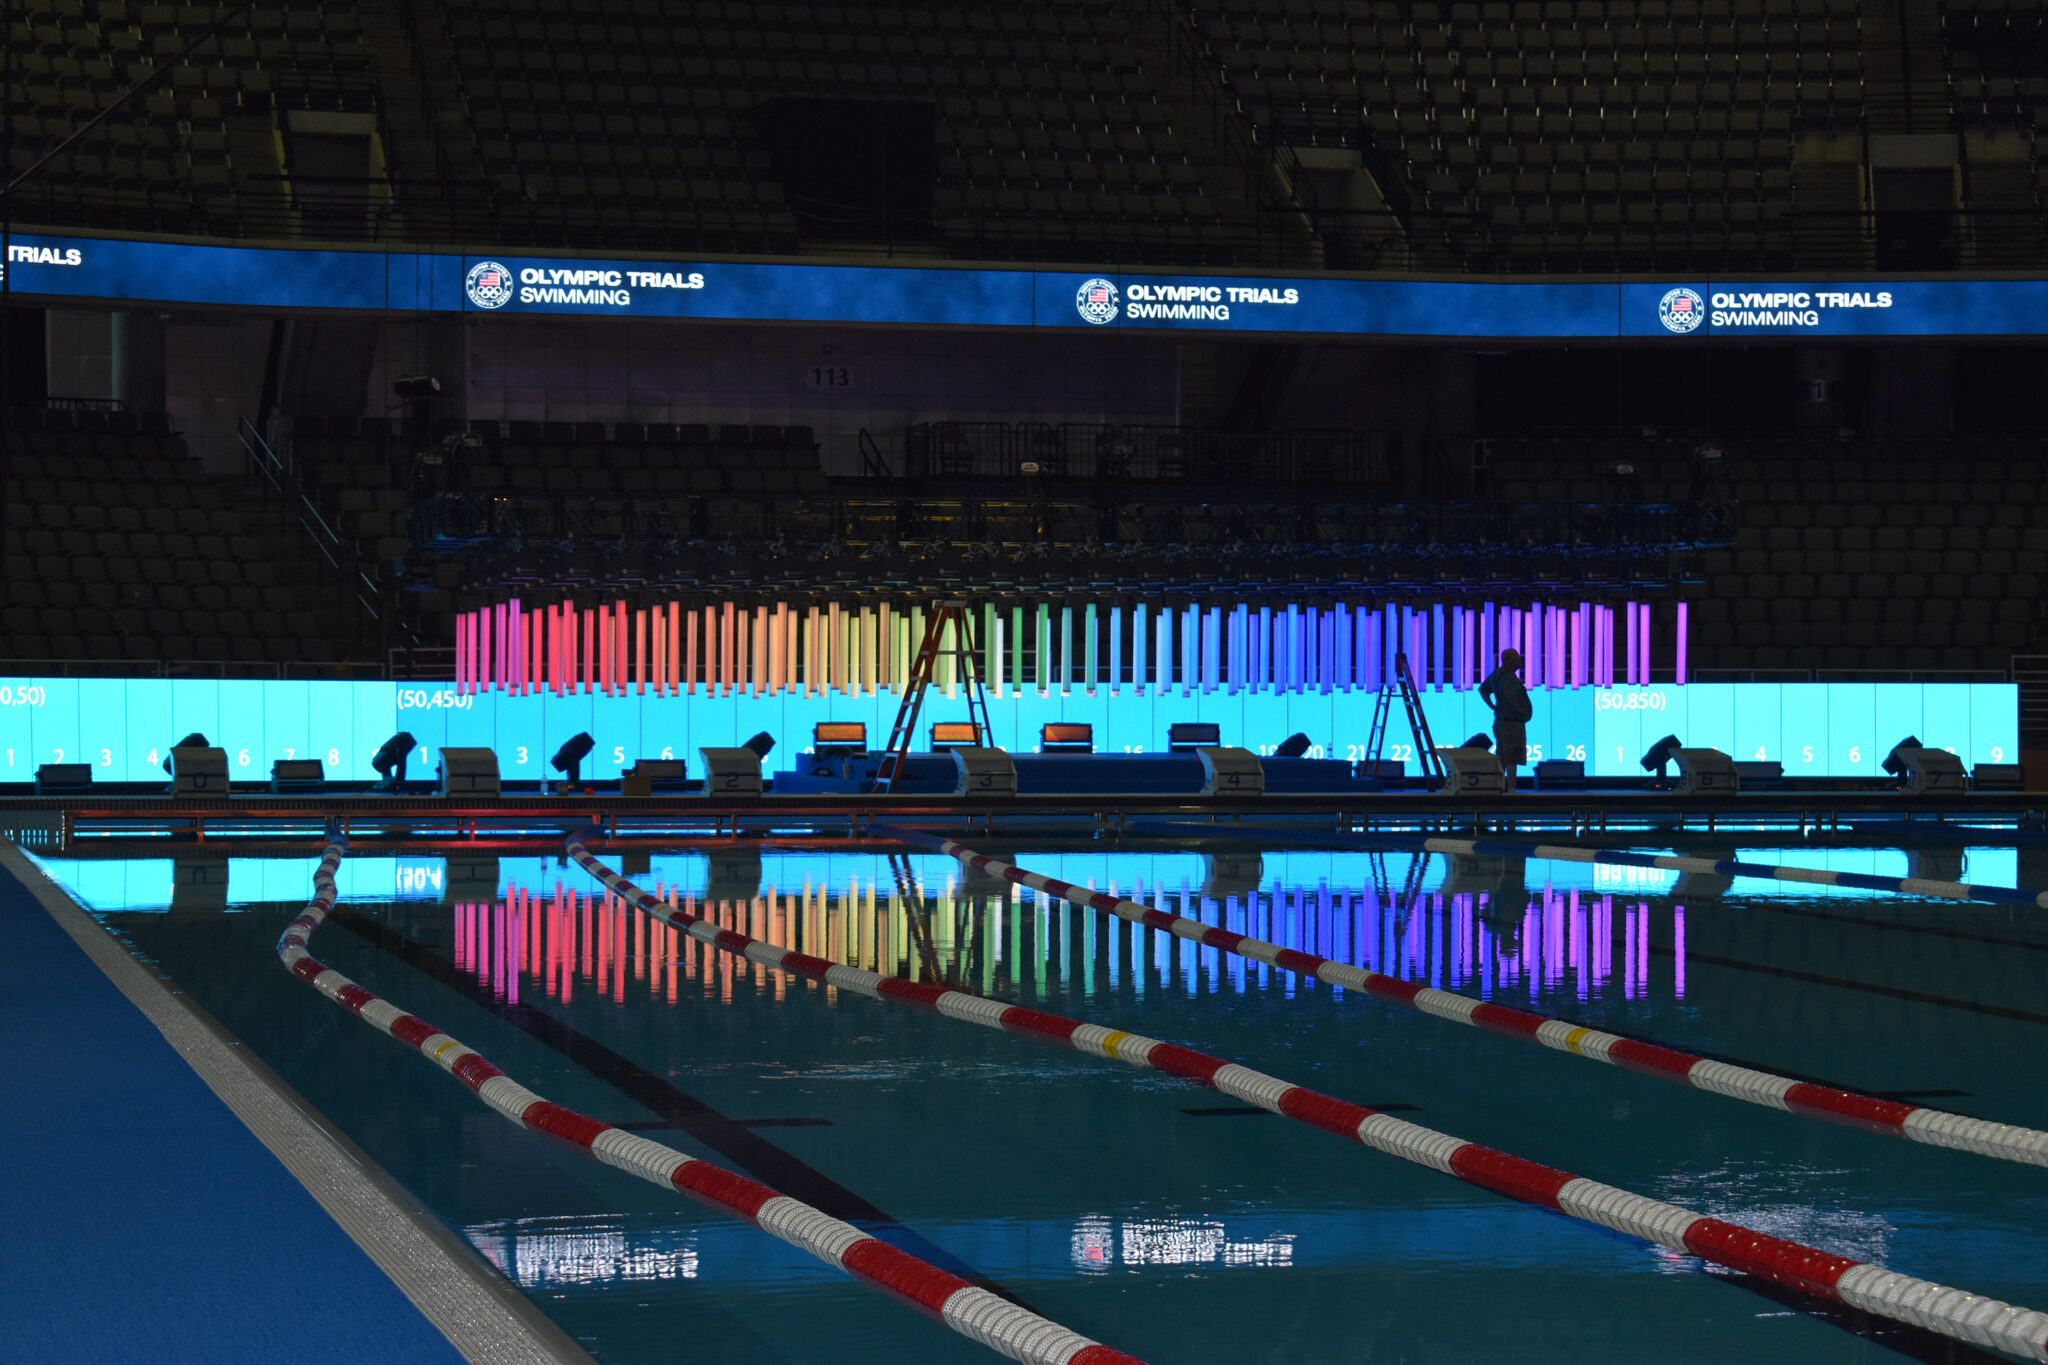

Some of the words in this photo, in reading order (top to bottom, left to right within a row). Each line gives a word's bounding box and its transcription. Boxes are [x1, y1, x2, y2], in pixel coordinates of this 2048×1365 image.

[8, 245, 82, 266] TRIALS
[520, 268, 622, 287] OLYMPIC
[627, 271, 704, 289] TRIALS
[520, 286, 630, 306] SWIMMING
[1127, 284, 1222, 302] OLYMPIC
[1226, 287, 1299, 304] TRIALS
[1711, 292, 1810, 308] OLYMPIC
[1815, 292, 1893, 308] TRIALS
[1126, 302, 1230, 320] SWIMMING
[1711, 310, 1819, 326] SWIMMING
[811, 368, 849, 386] 113
[397, 689, 473, 710] (50,450)
[1594, 691, 1667, 711] (50,850)
[6, 749, 14, 767] 1
[53, 749, 65, 764] 2
[100, 749, 112, 766] 3
[146, 748, 159, 766] 4
[238, 748, 250, 766] 6
[284, 749, 295, 761] 7
[328, 749, 340, 766] 8
[420, 747, 428, 764] 1
[516, 746, 528, 764] 3
[613, 746, 625, 764] 5
[661, 746, 674, 760] 6
[1347, 745, 1366, 761] 21
[1391, 744, 1412, 761] 22
[1525, 745, 1542, 761] 25
[1566, 745, 1586, 761] 26
[1616, 746, 1624, 763] 1
[1754, 746, 1767, 762] 4
[1802, 746, 1813, 763] 5
[1849, 746, 1861, 763] 6
[1991, 747, 2004, 763] 9
[726, 773, 739, 788] 2
[980, 774, 993, 787] 3
[1228, 771, 1240, 786] 4
[1468, 771, 1479, 786] 5
[1702, 771, 1713, 786] 6
[1931, 771, 1942, 785] 7
